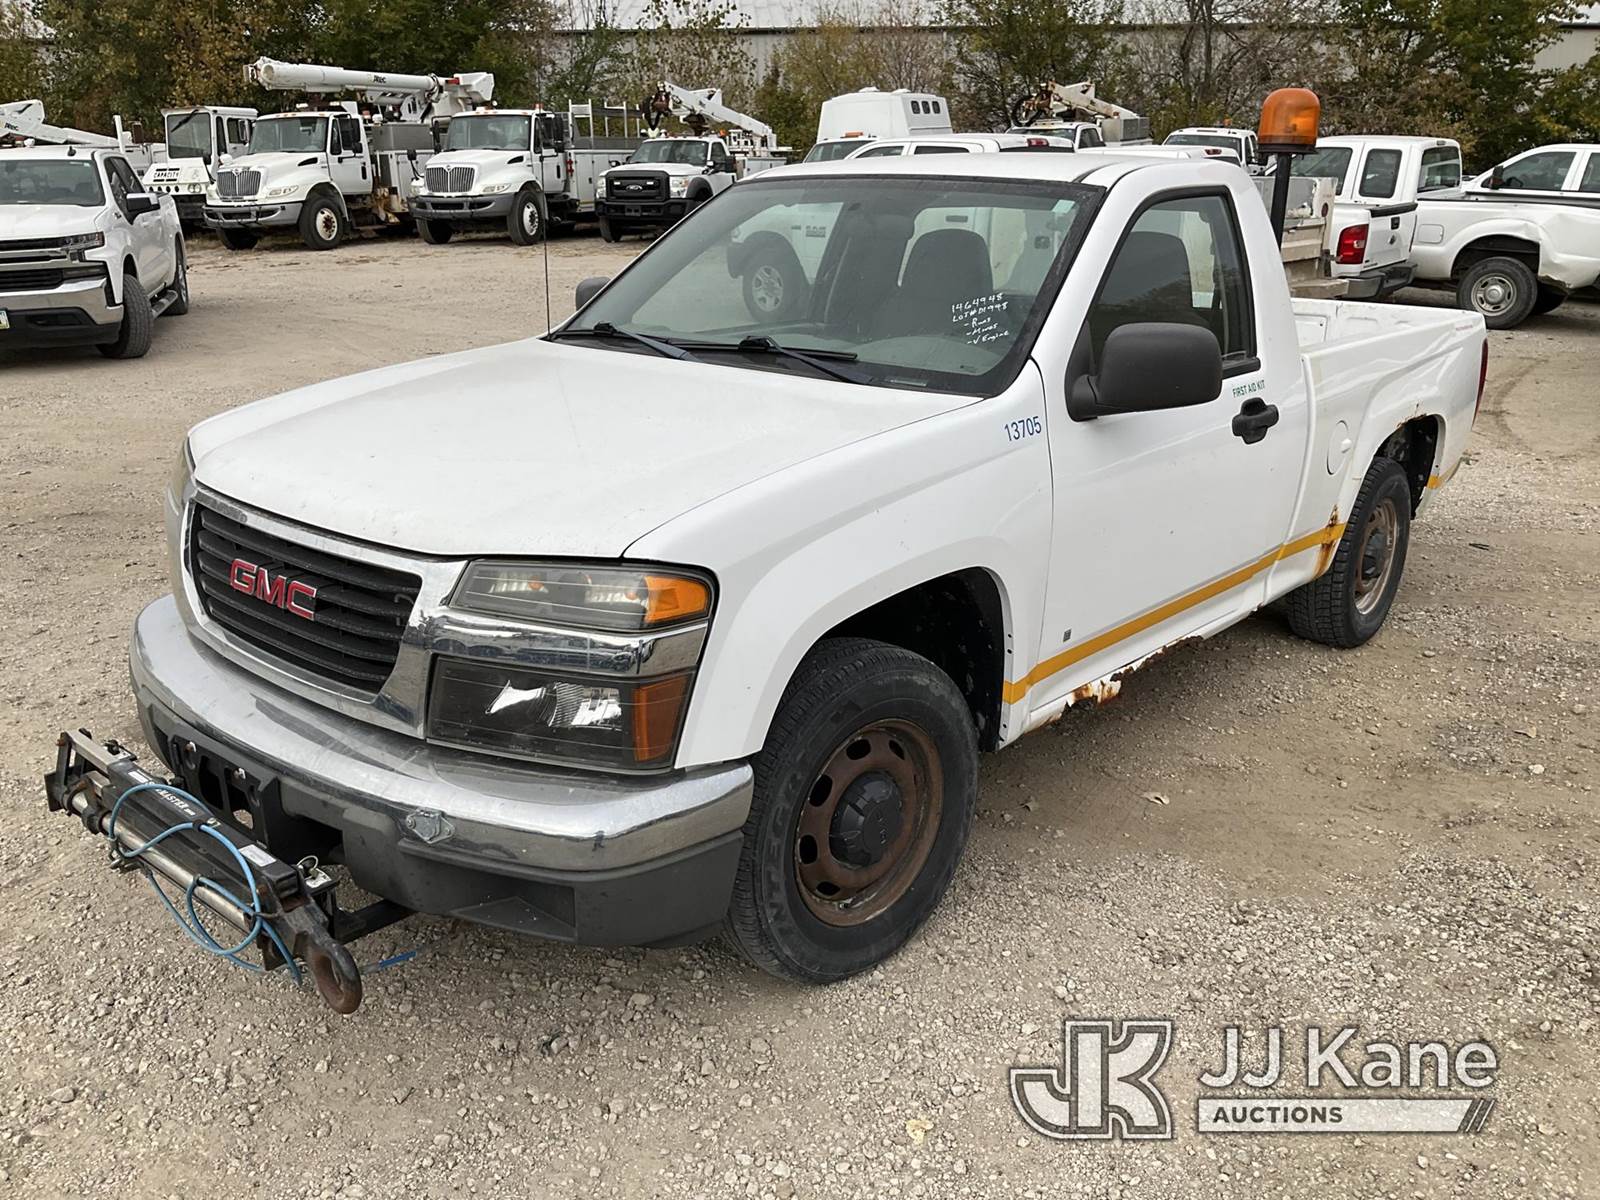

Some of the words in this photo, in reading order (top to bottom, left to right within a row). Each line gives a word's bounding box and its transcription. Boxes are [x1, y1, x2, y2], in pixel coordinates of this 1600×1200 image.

[951, 292, 1004, 314] 1464948
[1232, 384, 1248, 399] FIRST
[1248, 381, 1257, 393] AID
[1257, 379, 1266, 391] KIT
[1004, 415, 1042, 442] 13705
[229, 558, 318, 622] GMC
